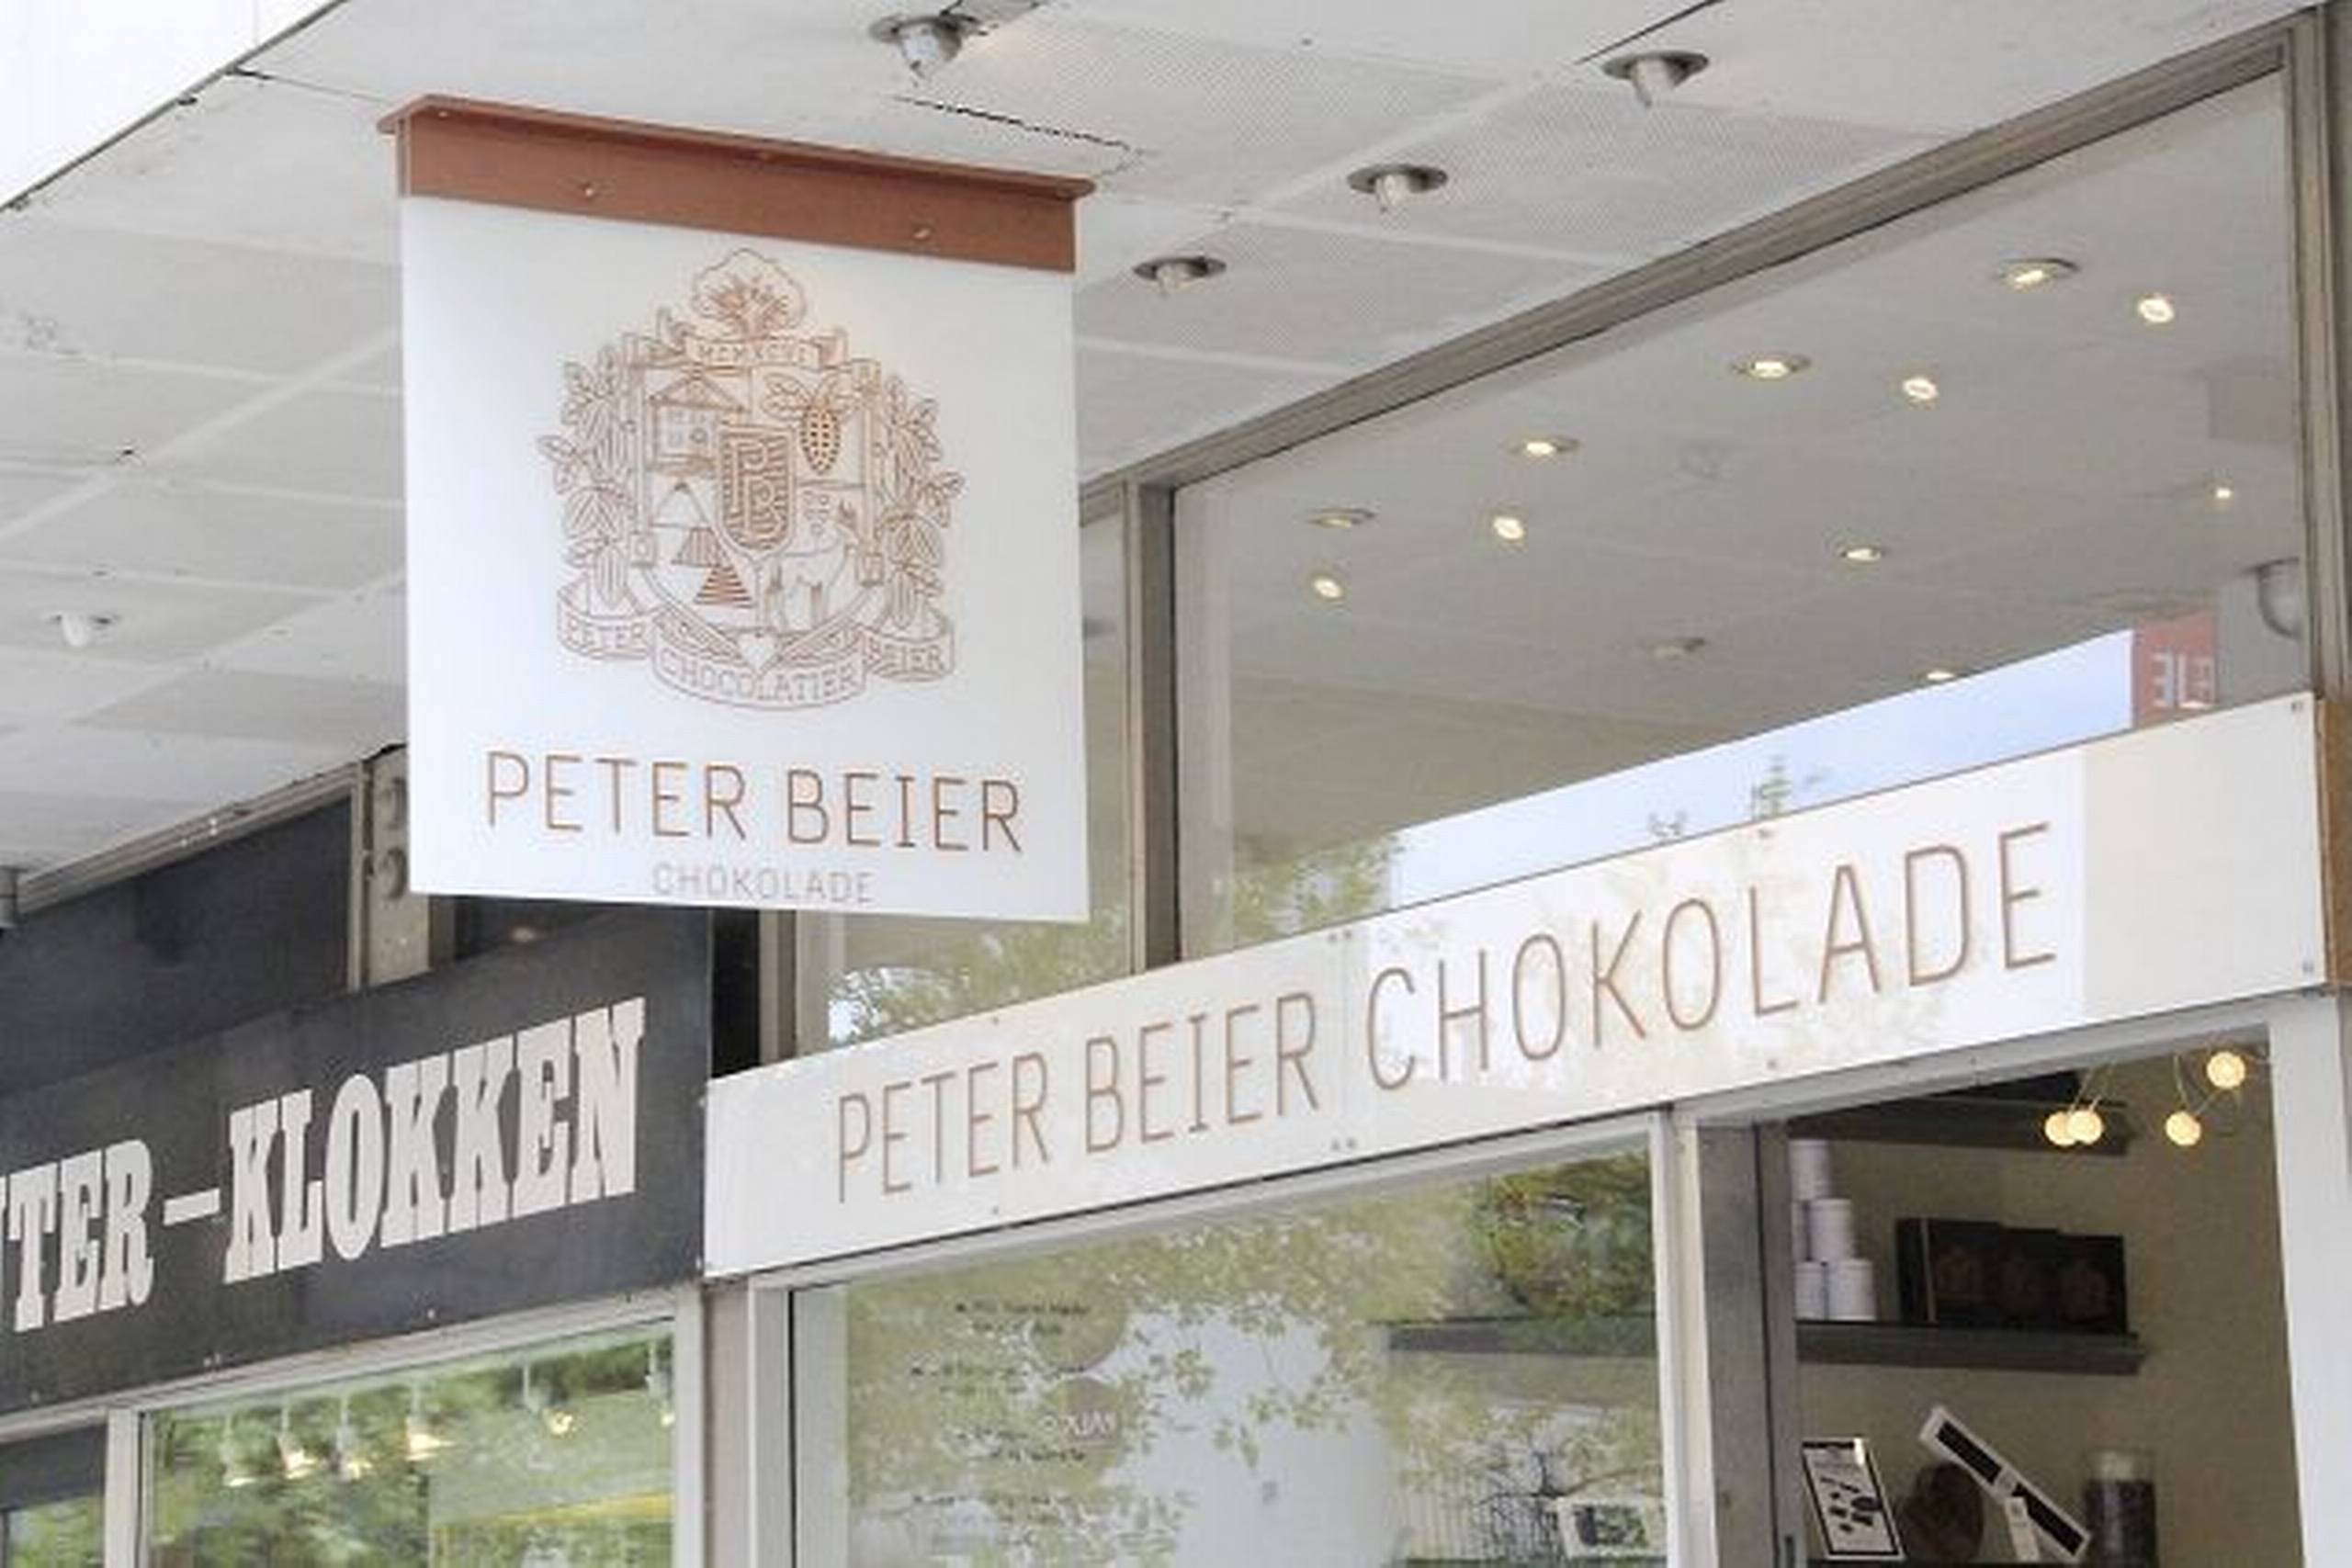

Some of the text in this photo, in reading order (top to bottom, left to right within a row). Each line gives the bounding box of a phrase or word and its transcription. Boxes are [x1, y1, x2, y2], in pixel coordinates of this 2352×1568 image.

[567, 619, 647, 649] PETER
[867, 636, 943, 673] BEIER
[659, 647, 861, 702] CHOCOLATIER
[485, 750, 747, 840] PETER
[786, 768, 1023, 855] BEIER
[650, 861, 876, 905] CHOKOLADE
[837, 821, 2058, 1205] PETER BEIER CHOKOLADE
[0, 996, 646, 1333] TER-KLOKKEN
